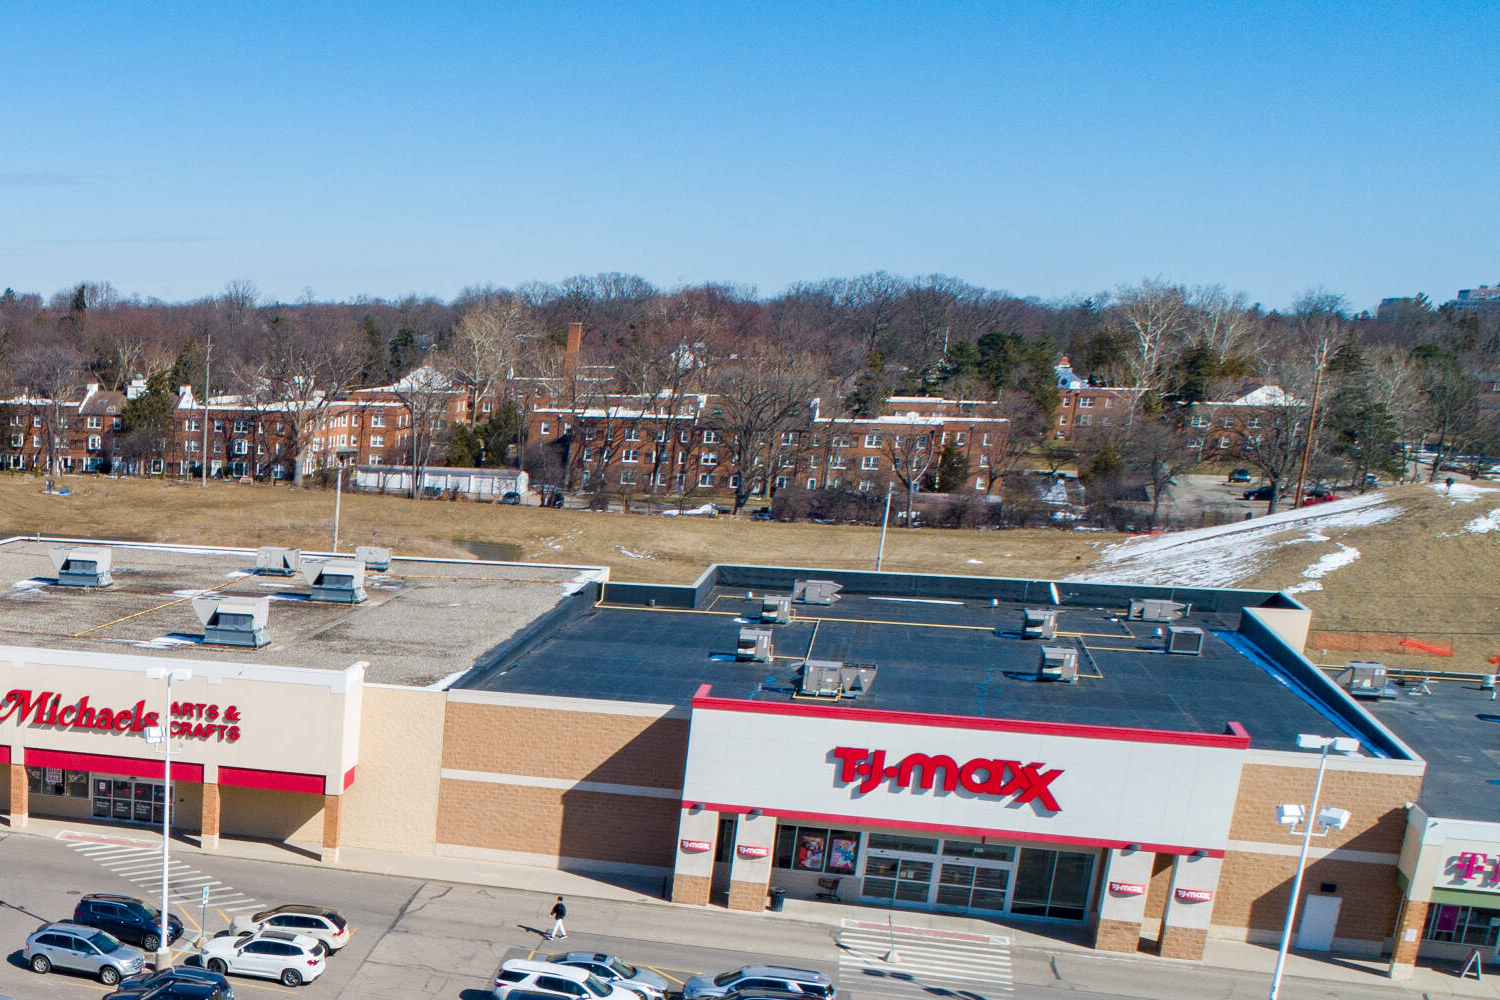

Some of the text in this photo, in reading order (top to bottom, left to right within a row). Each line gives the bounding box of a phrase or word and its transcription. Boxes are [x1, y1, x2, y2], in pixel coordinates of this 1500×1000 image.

[170, 701, 219, 720] ARTS
[225, 705, 241, 722] &
[170, 720, 241, 741] CRAFTS
